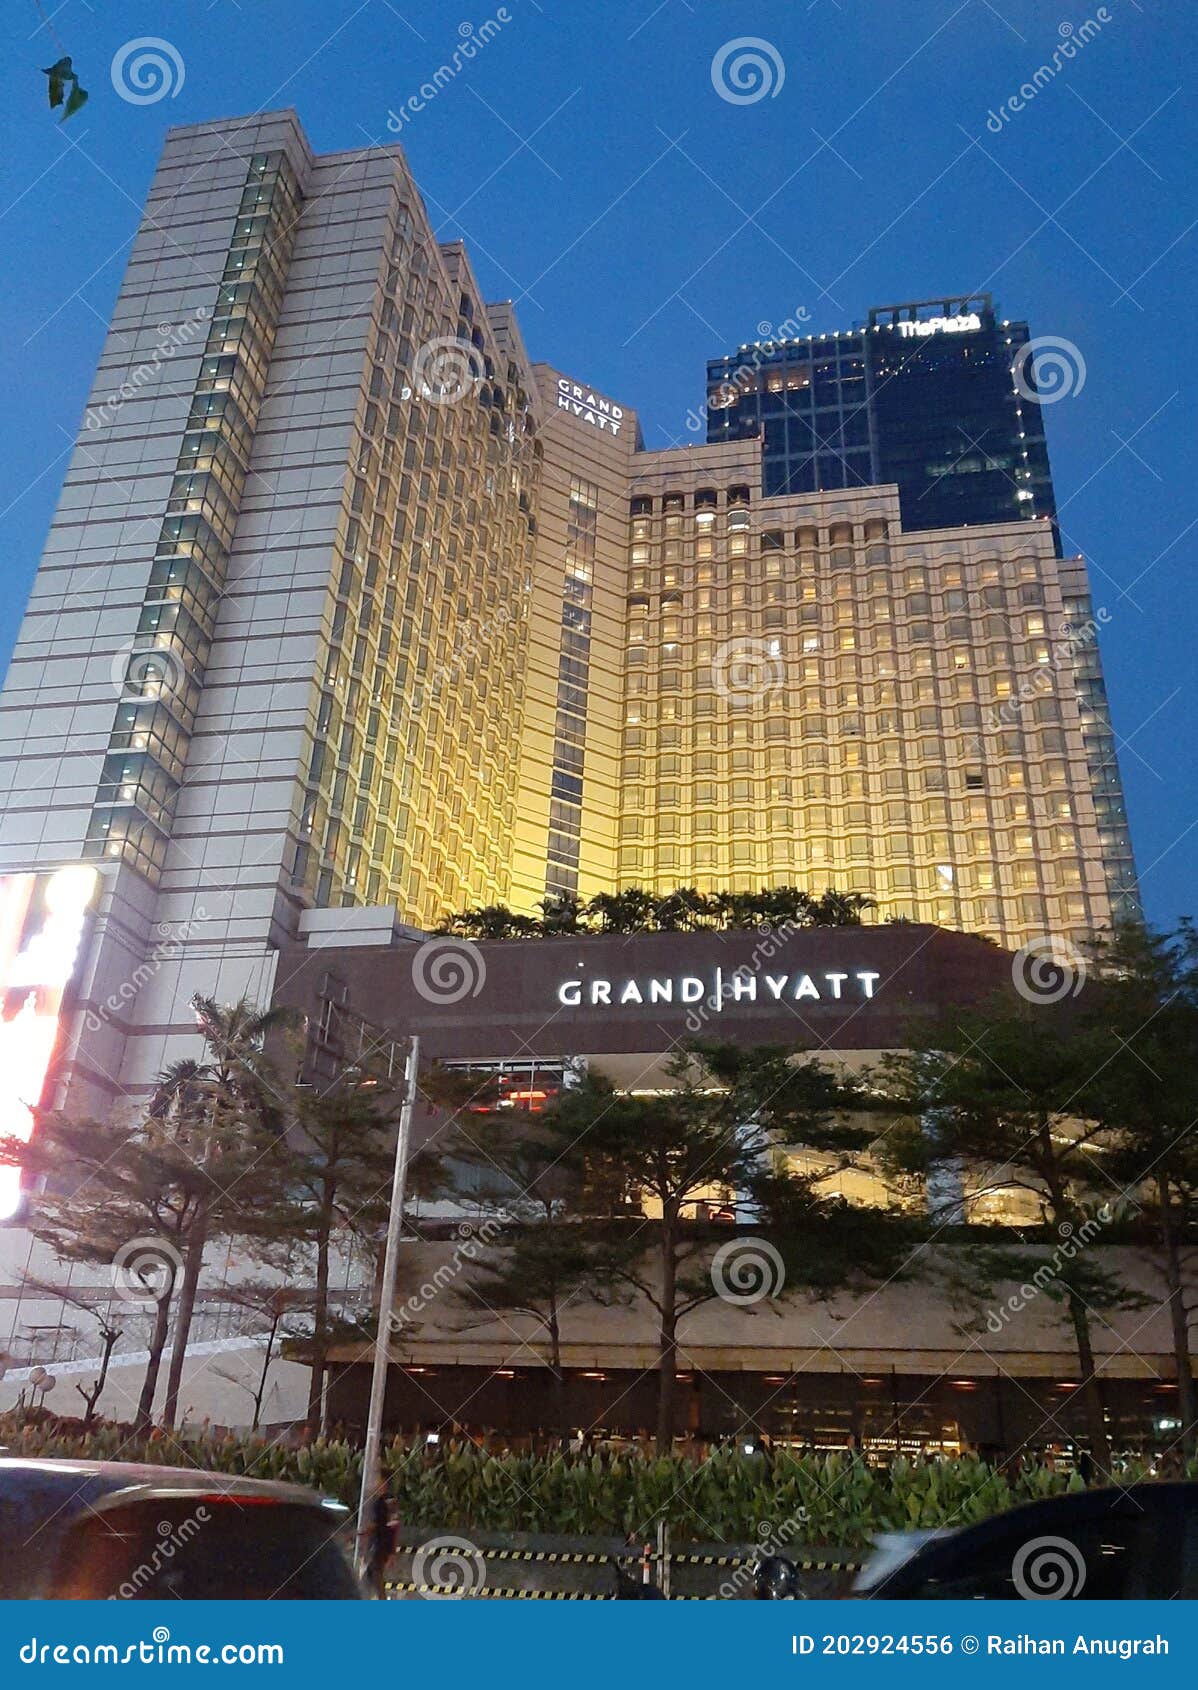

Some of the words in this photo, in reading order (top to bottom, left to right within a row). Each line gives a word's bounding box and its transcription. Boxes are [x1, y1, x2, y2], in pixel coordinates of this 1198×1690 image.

[558, 379, 622, 419] GRAND
[558, 396, 620, 436] HYATT
[558, 977, 705, 1005] GRAND
[732, 972, 880, 1001] HYATT
